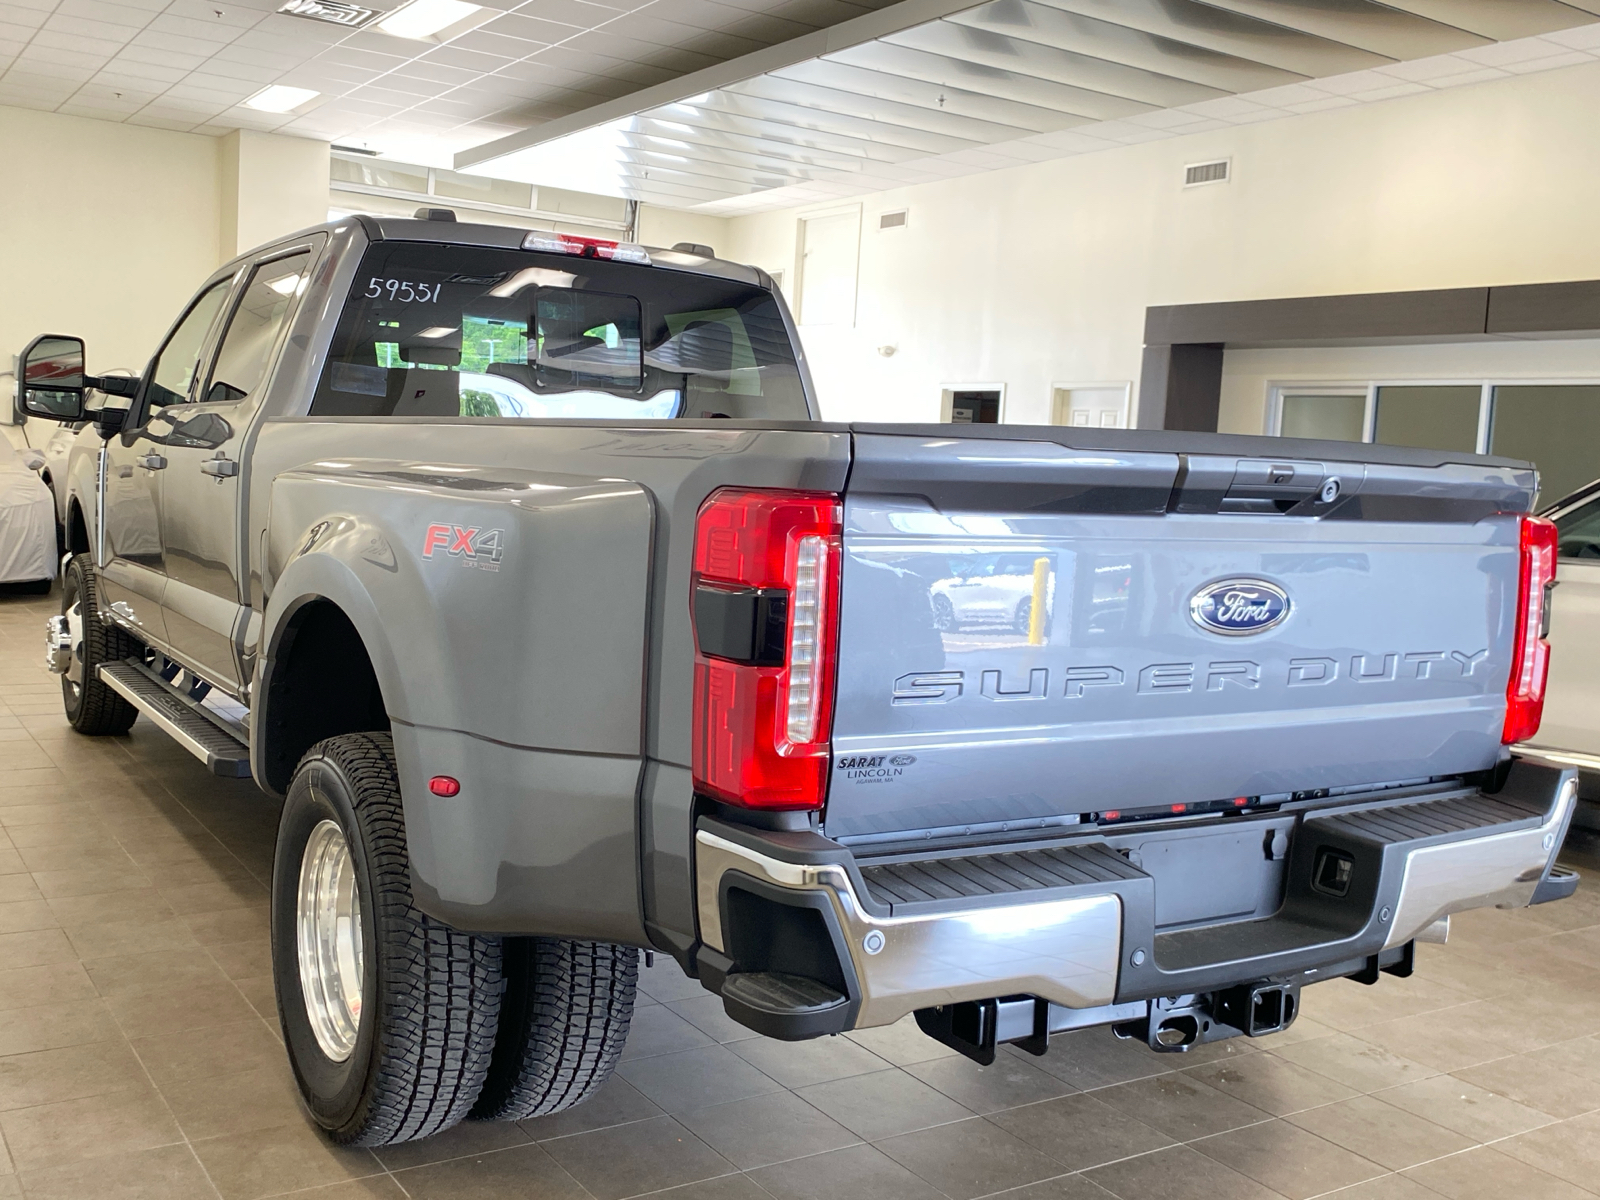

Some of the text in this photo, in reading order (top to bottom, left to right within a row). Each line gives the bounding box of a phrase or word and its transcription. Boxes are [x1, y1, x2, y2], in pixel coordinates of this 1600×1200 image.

[364, 277, 442, 303] 59551
[421, 521, 505, 564] FX4
[1216, 590, 1270, 622] Ford
[890, 648, 1489, 706] SUPER DUTY
[837, 755, 887, 770] SARAT
[847, 768, 903, 779] LINCOLN
